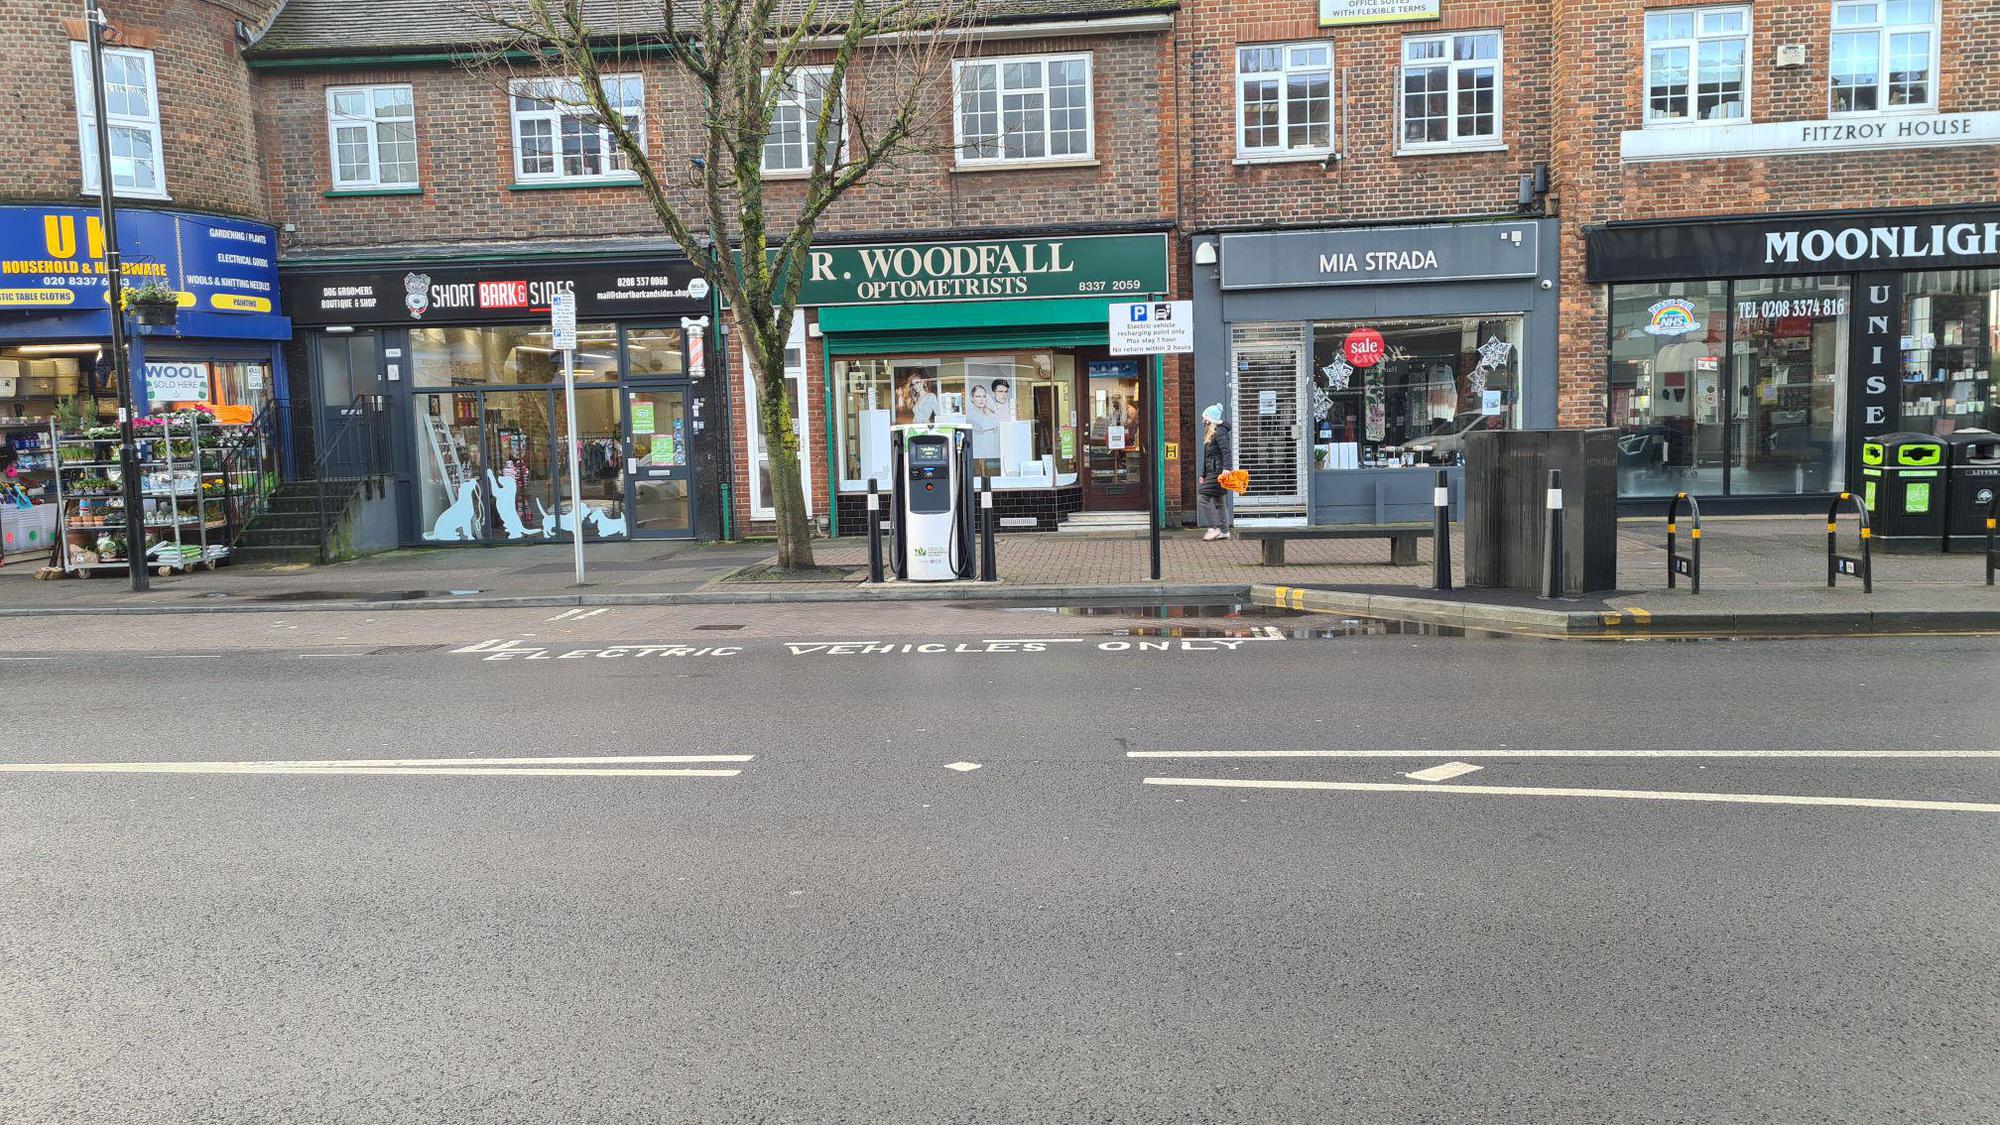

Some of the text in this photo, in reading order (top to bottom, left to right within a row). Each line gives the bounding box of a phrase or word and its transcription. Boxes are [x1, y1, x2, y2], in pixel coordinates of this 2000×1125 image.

[1333, 9, 1355, 17] WITH
[1357, 7, 1396, 15] FLEXIBLE
[1802, 119, 1971, 142] FITZROY HOUSE
[209, 228, 245, 241] GARDENING
[248, 233, 267, 244] PLANTS
[2, 260, 167, 276] HOUSEHOLD & HDWARE
[217, 253, 269, 268] ELECTRICAL GOODS
[809, 242, 1074, 281] R. WOODFALL
[1320, 250, 1438, 273] MIA STRADA
[43, 276, 130, 287] 020 8337 63
[187, 275, 271, 291] WOOLS & KNITTING NEEDLES
[617, 277, 635, 287] 0208
[636, 277, 650, 287] 337
[857, 276, 1028, 299] OPTOMETRISTS
[1079, 280, 1140, 291] 8337 2059
[0, 292, 71, 301] TIC TABLE CLOTHS
[323, 286, 373, 296] DOG GROOMERS
[431, 284, 475, 308] SHORT
[480, 283, 517, 306] BARK
[321, 299, 353, 309] BOUTIQUE
[360, 298, 377, 308] SHOP
[1738, 298, 1845, 318] TEL 0208 3374 816
[1661, 317, 1684, 327] NHS
[1351, 338, 1378, 354] sale
[1865, 285, 1891, 440] UNISE
[145, 365, 204, 379] WOOL
[154, 380, 198, 389] SOLD HERE
[1165, 445, 1177, 458] H
[482, 640, 1245, 661] ELECTRIC VEHICLES ONLY
